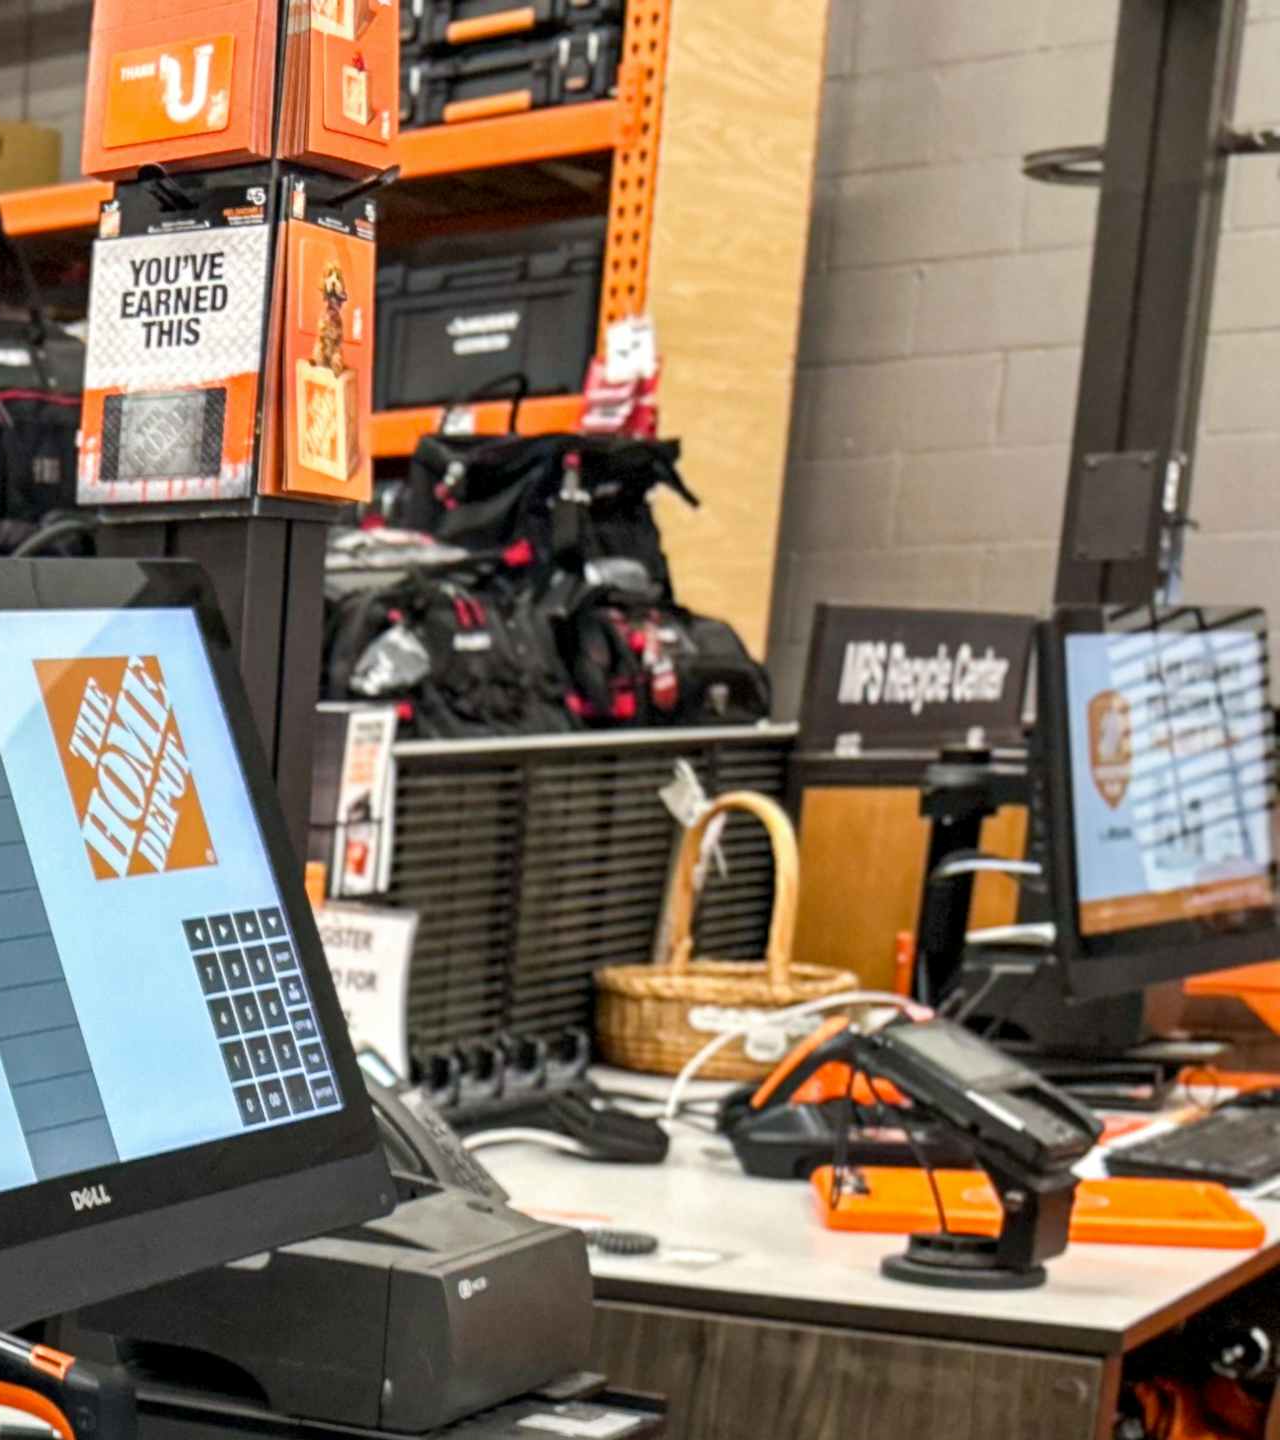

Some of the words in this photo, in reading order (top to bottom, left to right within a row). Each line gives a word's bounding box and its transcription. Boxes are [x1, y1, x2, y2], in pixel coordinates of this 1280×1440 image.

[129, 252, 226, 287] YOU'VE
[120, 283, 228, 319] EARNED
[141, 319, 201, 349] THIS
[81, 655, 172, 878] HOME
[138, 732, 192, 873] DEPOT
[70, 1184, 112, 1212] DELL
